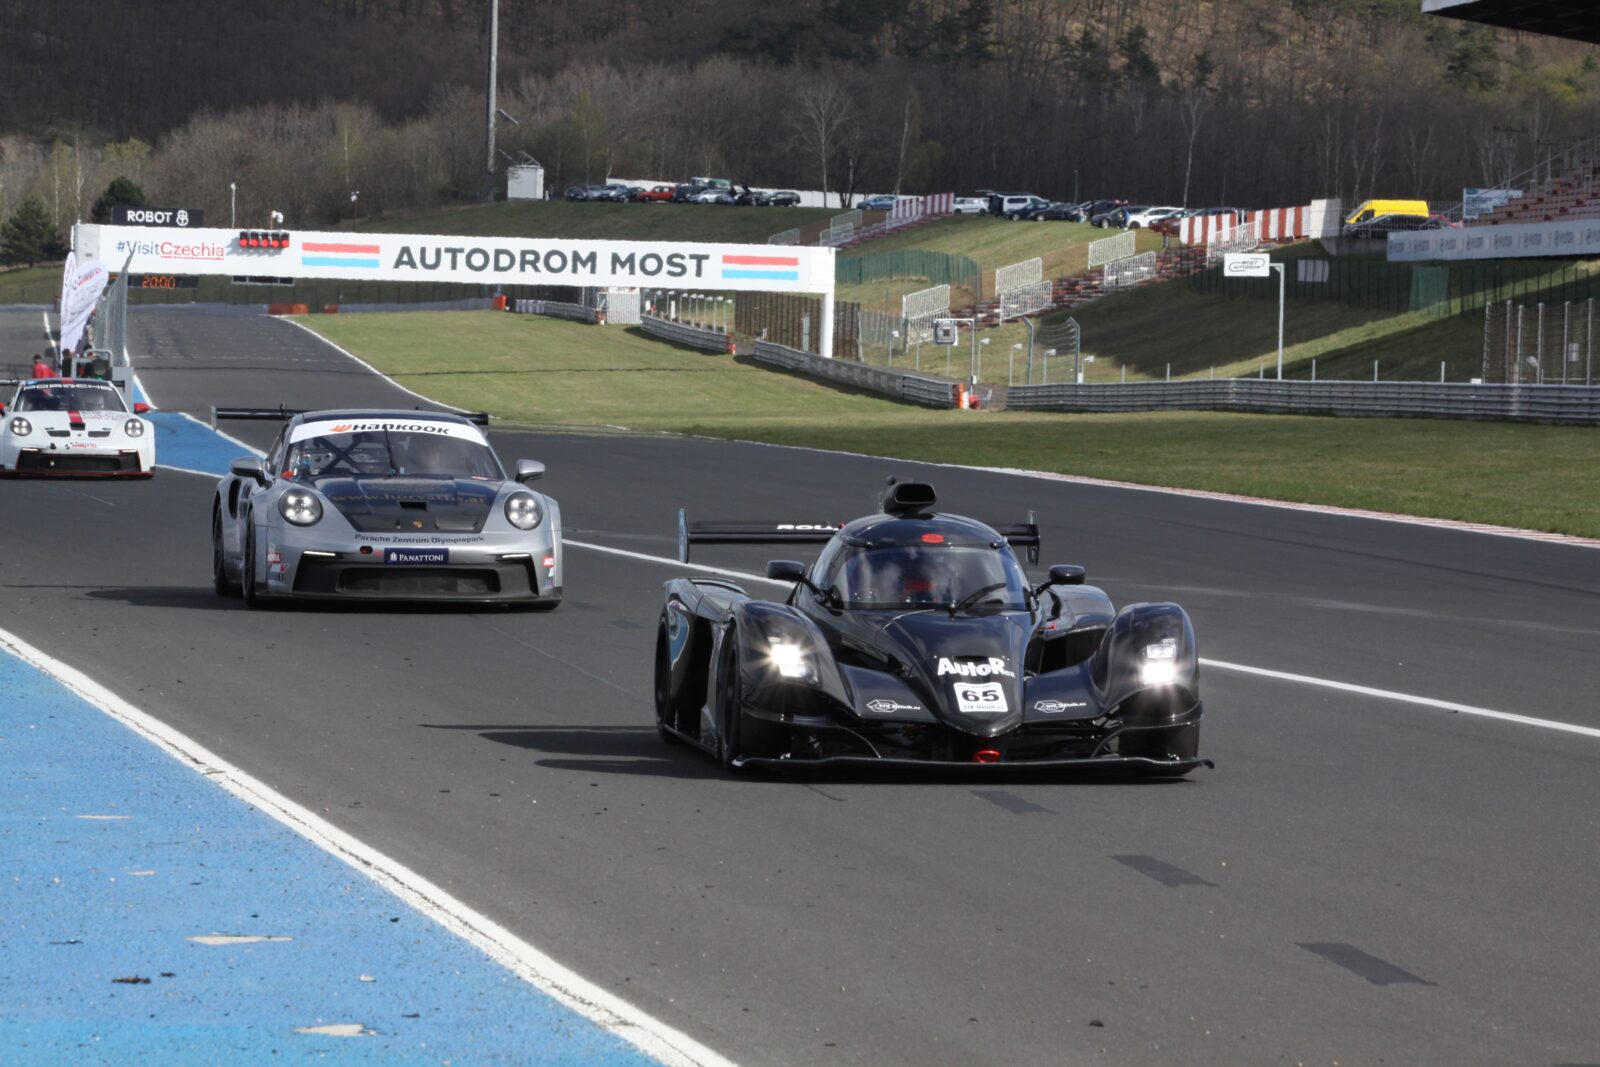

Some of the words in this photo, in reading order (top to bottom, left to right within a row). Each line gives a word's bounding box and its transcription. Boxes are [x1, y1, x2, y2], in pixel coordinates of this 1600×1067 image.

[127, 210, 172, 223] ROBOT
[116, 240, 225, 257] #VisitCzechia
[393, 245, 598, 275] AUTODROM
[610, 251, 710, 278] MOST
[354, 533, 391, 542] Porsche
[431, 536, 484, 544] Olympiapark
[399, 554, 444, 562] PANATTONI
[961, 689, 1000, 702] 65
